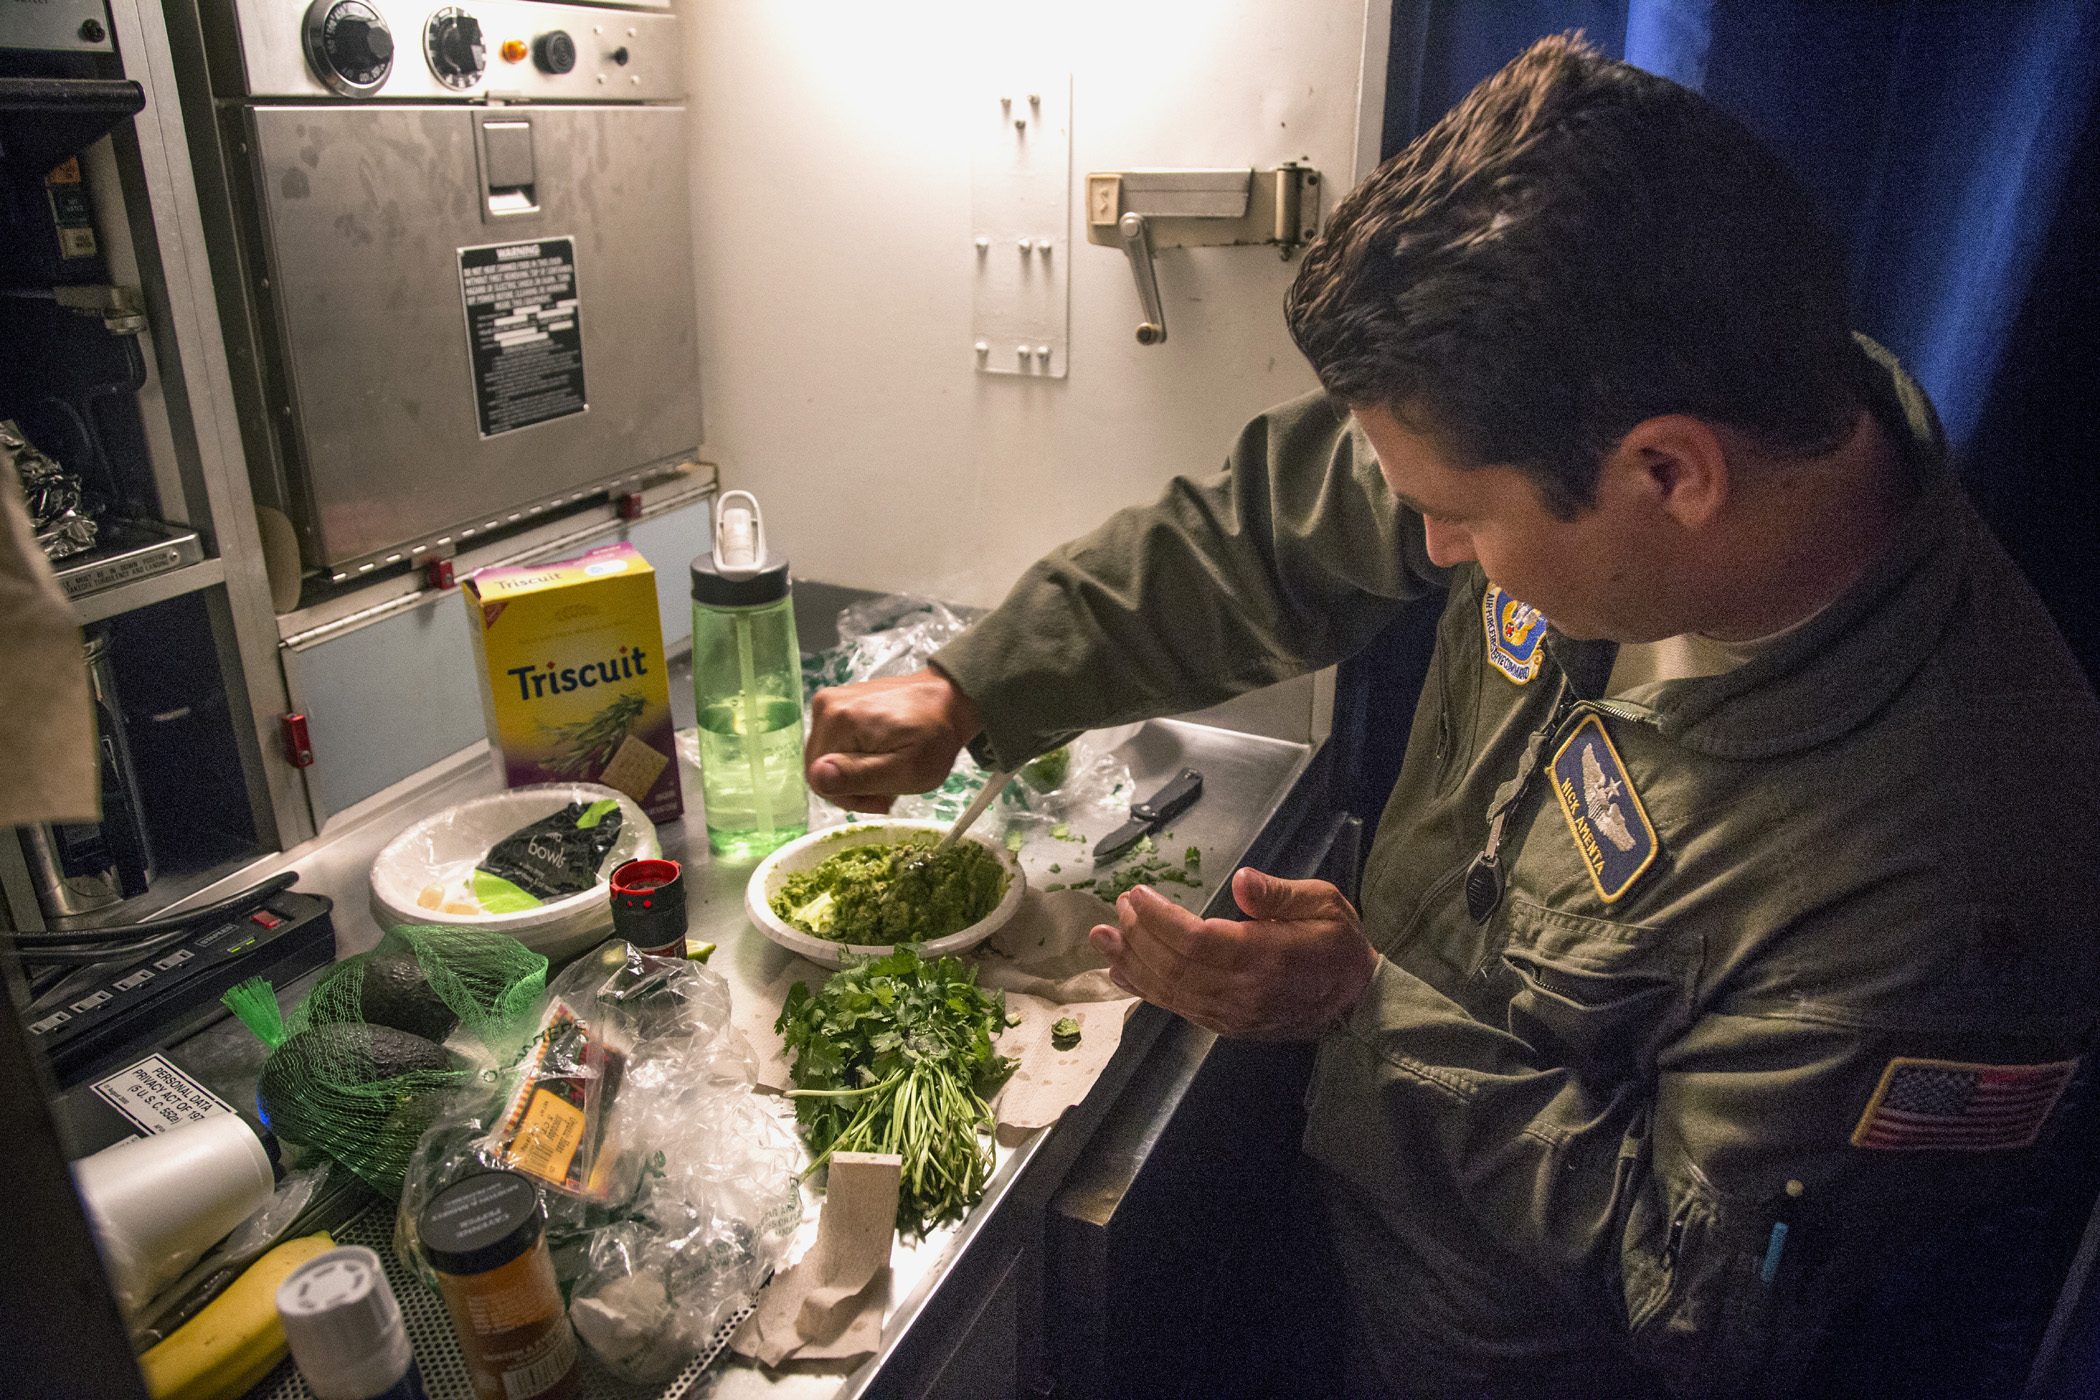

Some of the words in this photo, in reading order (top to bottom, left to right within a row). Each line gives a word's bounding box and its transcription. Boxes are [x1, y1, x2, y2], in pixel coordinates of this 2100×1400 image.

[496, 244, 540, 260] WARNING
[120, 562, 138, 571] DOWN
[142, 553, 167, 564] POSITION
[132, 566, 144, 576] AND
[145, 560, 169, 572] LANDING
[495, 572, 563, 590] Triscuit
[1486, 593, 1495, 608] AIR
[1486, 609, 1496, 635] FORCE
[507, 645, 648, 700] Triscuit
[1504, 657, 1530, 680] COMMAND
[1561, 778, 1580, 816] NICK
[1575, 816, 1605, 875] AMENTA
[528, 835, 566, 868] bowls
[132, 1069, 167, 1093] PRIVACY
[161, 1091, 182, 1105] ACT
[176, 1102, 192, 1114] OF
[188, 1110, 205, 1122] 197
[152, 1067, 193, 1098] PERSONAL
[189, 1092, 213, 1112] DATA
[160, 1107, 182, 1125] 552a)
